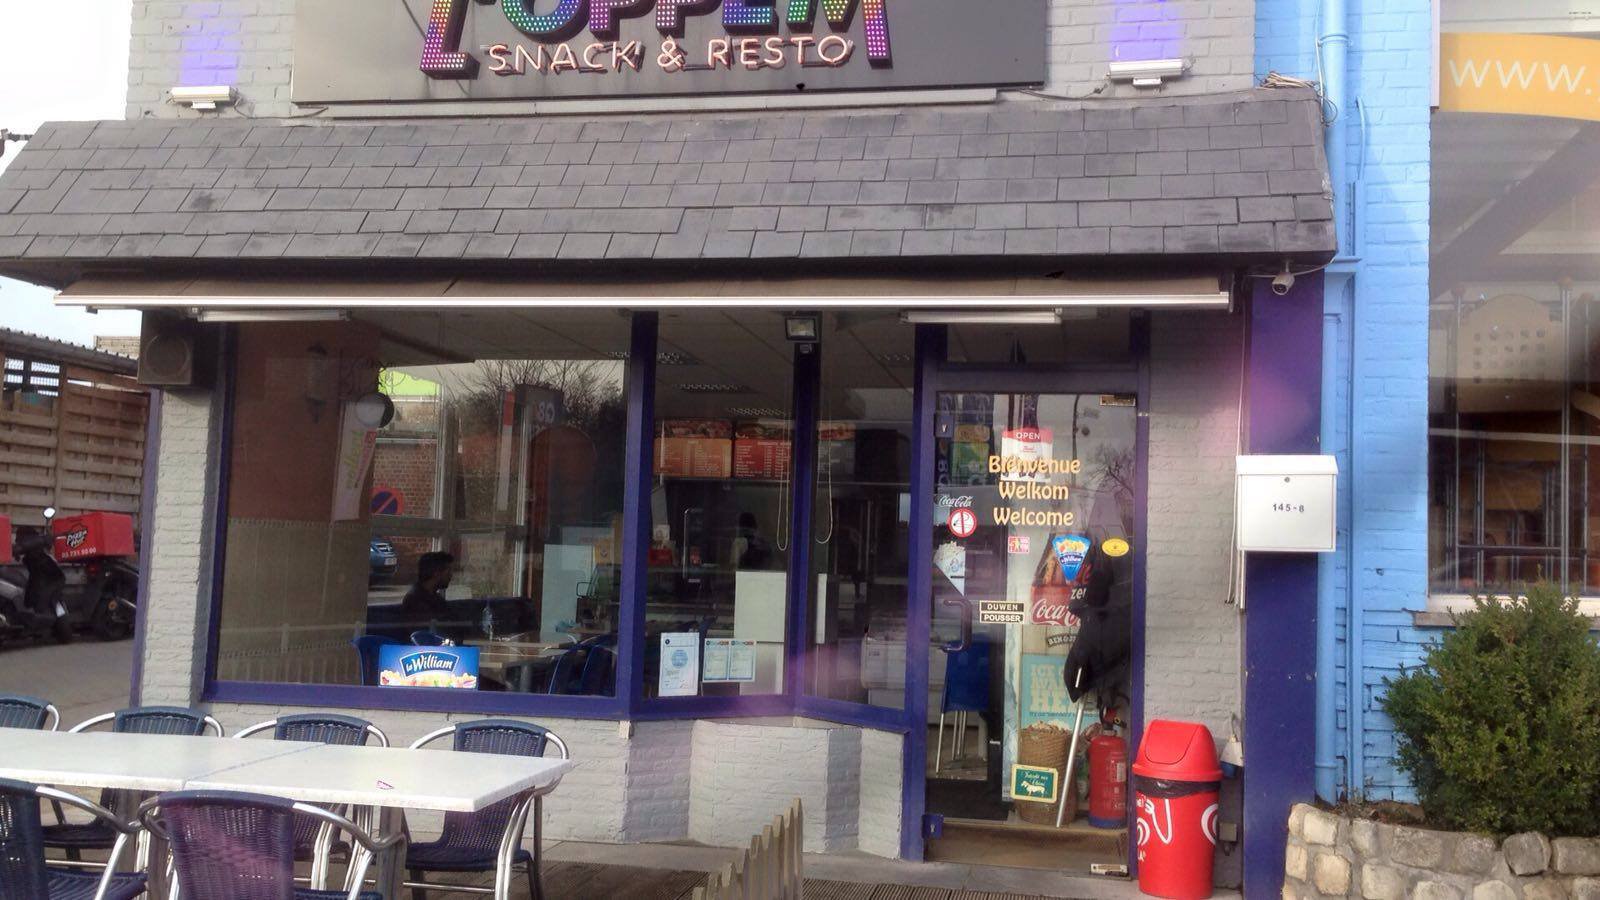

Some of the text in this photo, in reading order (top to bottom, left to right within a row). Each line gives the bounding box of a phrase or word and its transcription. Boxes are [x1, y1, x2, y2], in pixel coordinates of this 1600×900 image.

[488, 35, 848, 72] SNACK & RESTO
[1016, 432, 1040, 440] OPEN
[989, 455, 1081, 474] Bienvenue
[998, 481, 1069, 500] Welkom
[993, 507, 1074, 526] Welcome
[987, 603, 1018, 611] DUWEN
[984, 614, 1021, 622] POUSSER
[412, 653, 453, 672] William
